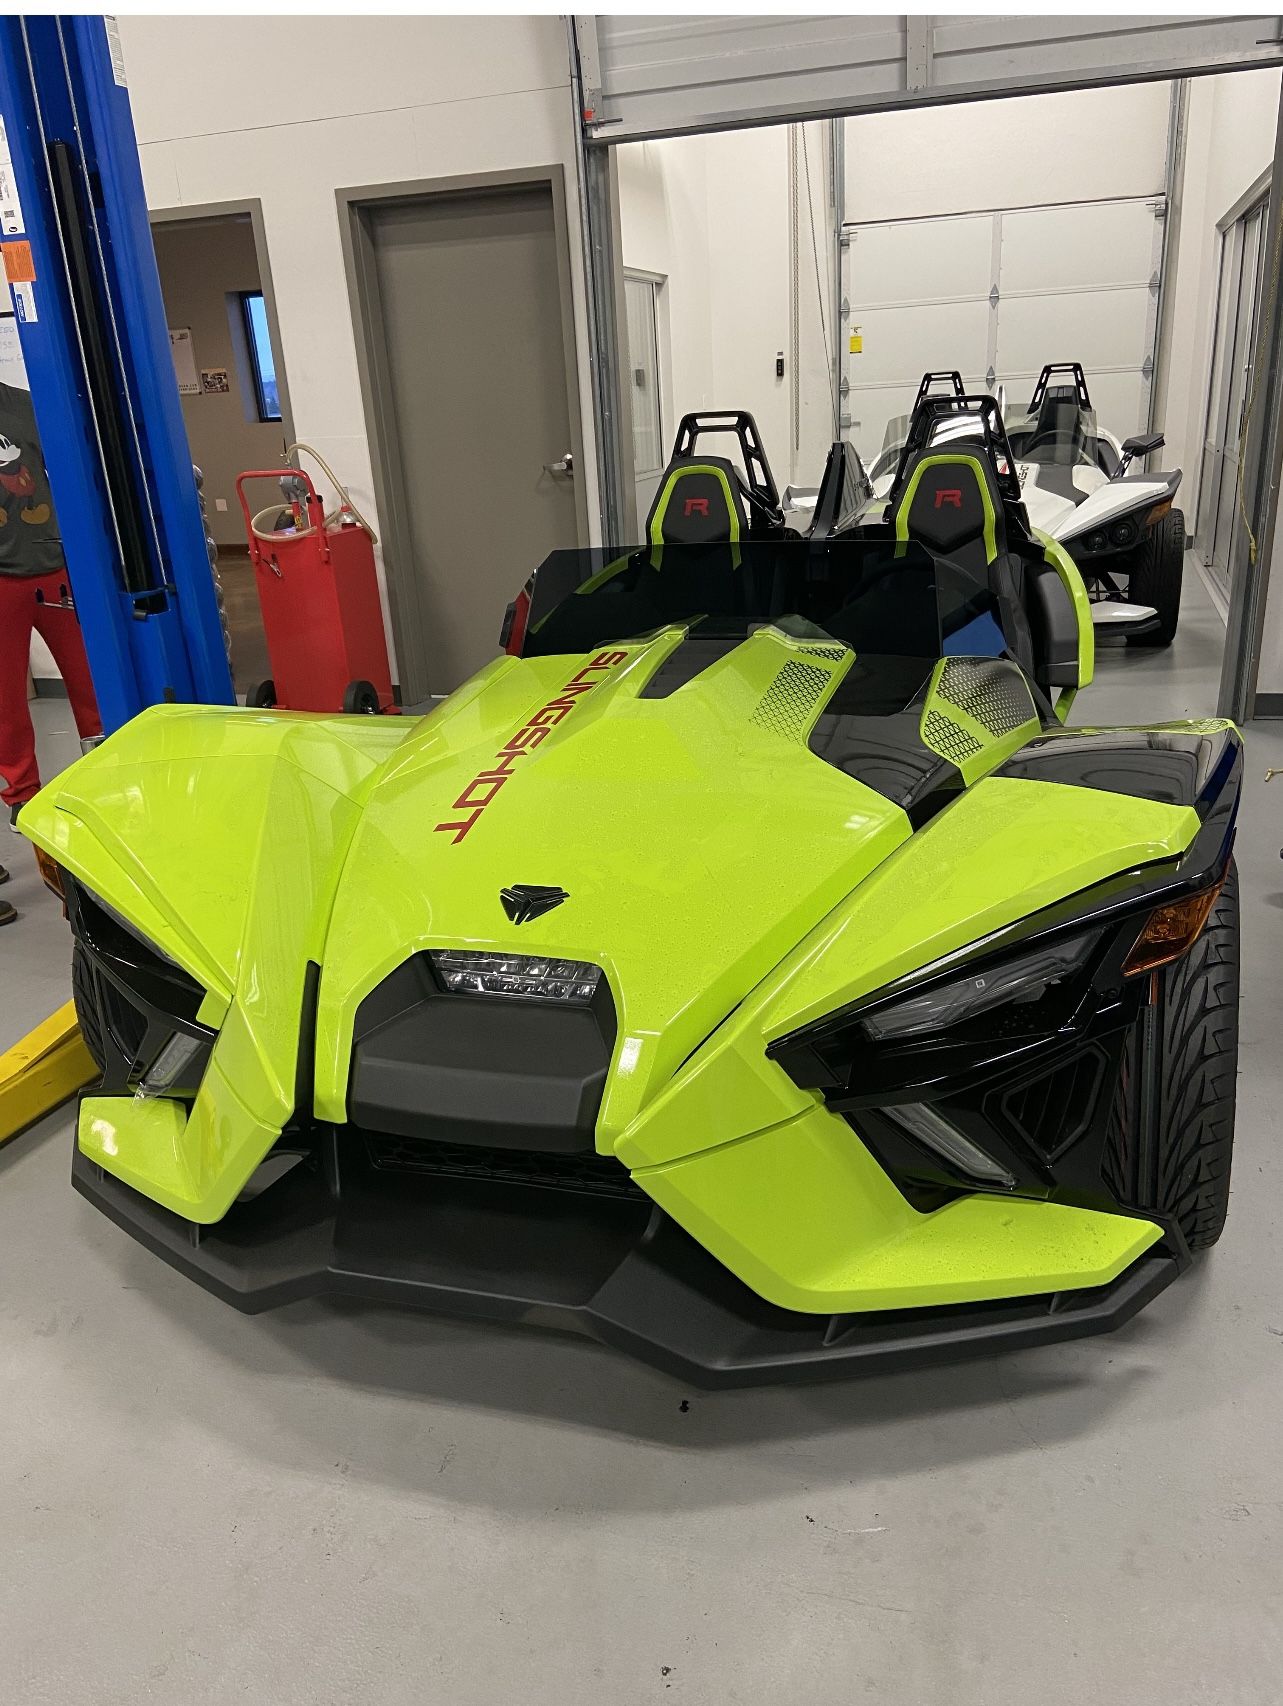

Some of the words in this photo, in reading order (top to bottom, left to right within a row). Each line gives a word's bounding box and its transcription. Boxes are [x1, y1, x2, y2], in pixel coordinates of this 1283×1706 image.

[684, 498, 709, 516] R
[934, 490, 961, 508] R
[433, 651, 628, 845] SLINGSHOT
